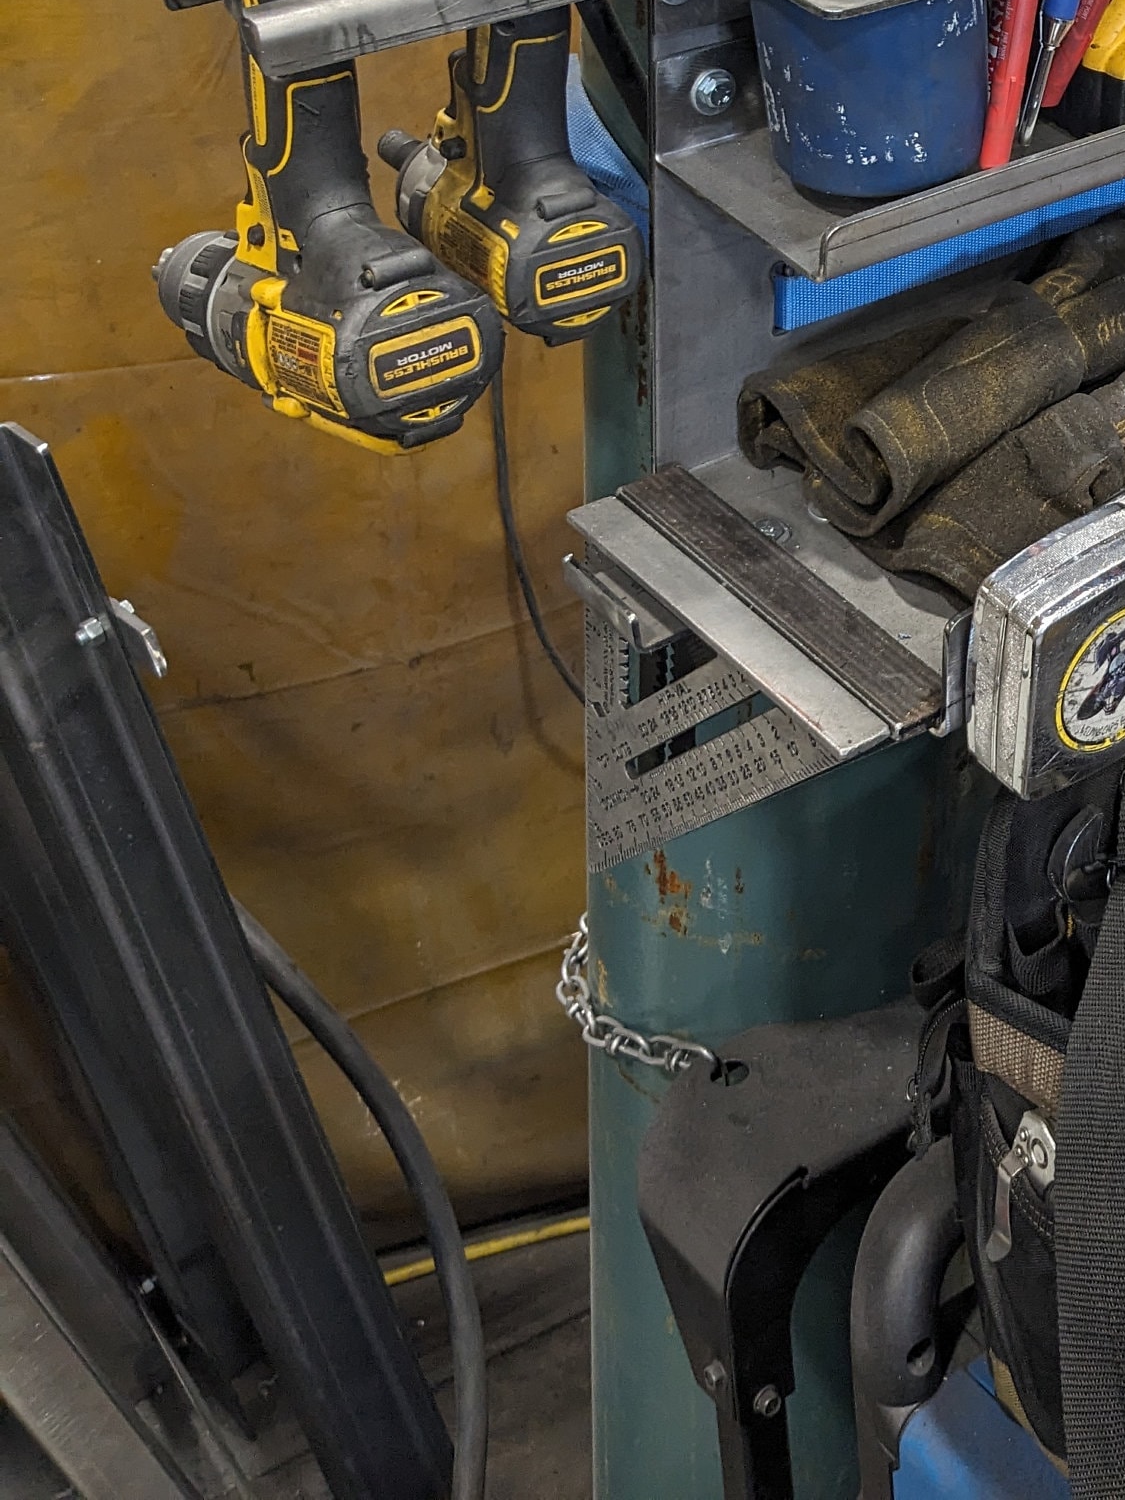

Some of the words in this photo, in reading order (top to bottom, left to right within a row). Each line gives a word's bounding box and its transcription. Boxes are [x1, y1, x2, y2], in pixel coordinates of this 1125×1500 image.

[545, 263, 617, 291] BRUSHLESS
[557, 260, 605, 279] MOTOR
[383, 344, 469, 381] BRUSHLESS
[396, 342, 453, 366] MOTOR
